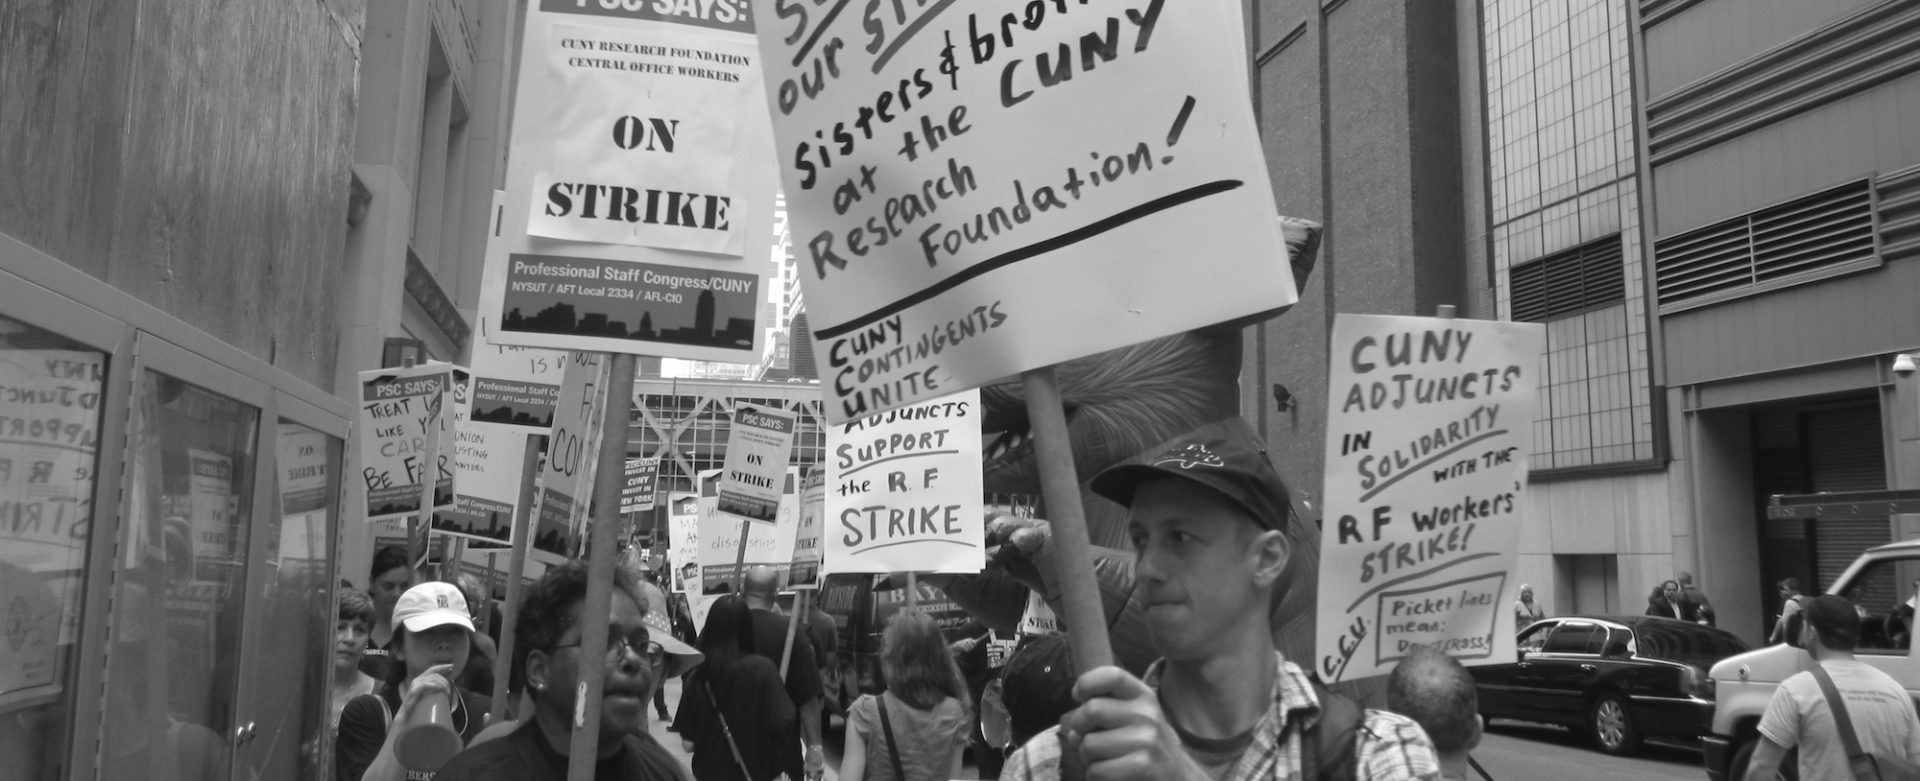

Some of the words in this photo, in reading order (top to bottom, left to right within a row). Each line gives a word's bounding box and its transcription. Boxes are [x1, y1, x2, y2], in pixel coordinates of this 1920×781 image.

[561, 38, 596, 51] CUNY
[599, 41, 666, 57] RESEARCH
[670, 48, 751, 67] FOUNDATION
[568, 57, 627, 71] CENTRAL
[629, 62, 675, 75] OFFICE
[678, 66, 740, 83] WORKERS
[778, 37, 844, 115] our
[795, 68, 933, 190] Sisters
[939, 30, 960, 90] &
[833, 165, 877, 215] at
[897, 105, 972, 162] the
[1000, 0, 1166, 108] CUNY
[612, 115, 680, 153] ON
[919, 95, 1196, 268] Foundation!
[545, 182, 731, 231] STRIKE
[808, 158, 977, 280] Research
[514, 260, 600, 280] Professional
[603, 266, 641, 284] Staff
[643, 270, 753, 294] Congress/CUNY
[512, 281, 547, 294] NYSUT
[556, 284, 577, 295] AFT
[578, 285, 605, 297] Local
[607, 287, 635, 299] 2334
[644, 290, 683, 304] AFL-CIO
[829, 314, 901, 368] CUNY
[835, 300, 1008, 397] CONTINGENTS
[1351, 329, 1473, 374] CUNY
[376, 383, 402, 397] PSC
[404, 379, 439, 394] SAYS:
[477, 382, 527, 394] Professional
[528, 386, 550, 396] Staff
[843, 365, 939, 418] UNITE
[1342, 365, 1521, 413] ADJUNCTS
[363, 398, 410, 419] TREAT
[742, 413, 759, 424] PSC
[759, 416, 785, 430] SAYS:
[845, 401, 970, 434] ADJUNCTS
[376, 425, 404, 438] LIKE
[454, 431, 485, 444] UNION
[1342, 431, 1371, 456] IN
[454, 446, 488, 460] USTING
[747, 453, 763, 466] ON
[836, 429, 950, 470] SUPPORT
[1358, 404, 1500, 490] SOLIDARITY
[363, 467, 393, 490] BE
[404, 455, 454, 485] FAR
[624, 467, 647, 476] INVEST
[1433, 454, 1477, 482] WITH
[1482, 447, 1518, 467] THE
[622, 486, 643, 495] INVEST
[627, 475, 650, 487] CUNY
[730, 470, 774, 489] STRIKE
[837, 479, 871, 497] the
[634, 494, 653, 503] YORK
[683, 503, 698, 513] PS
[840, 504, 963, 547] STRIKE
[1360, 523, 1475, 583] STRIKE!
[1392, 597, 1453, 616] Picket
[1459, 590, 1493, 608] lines
[1386, 621, 1446, 635] mean:
